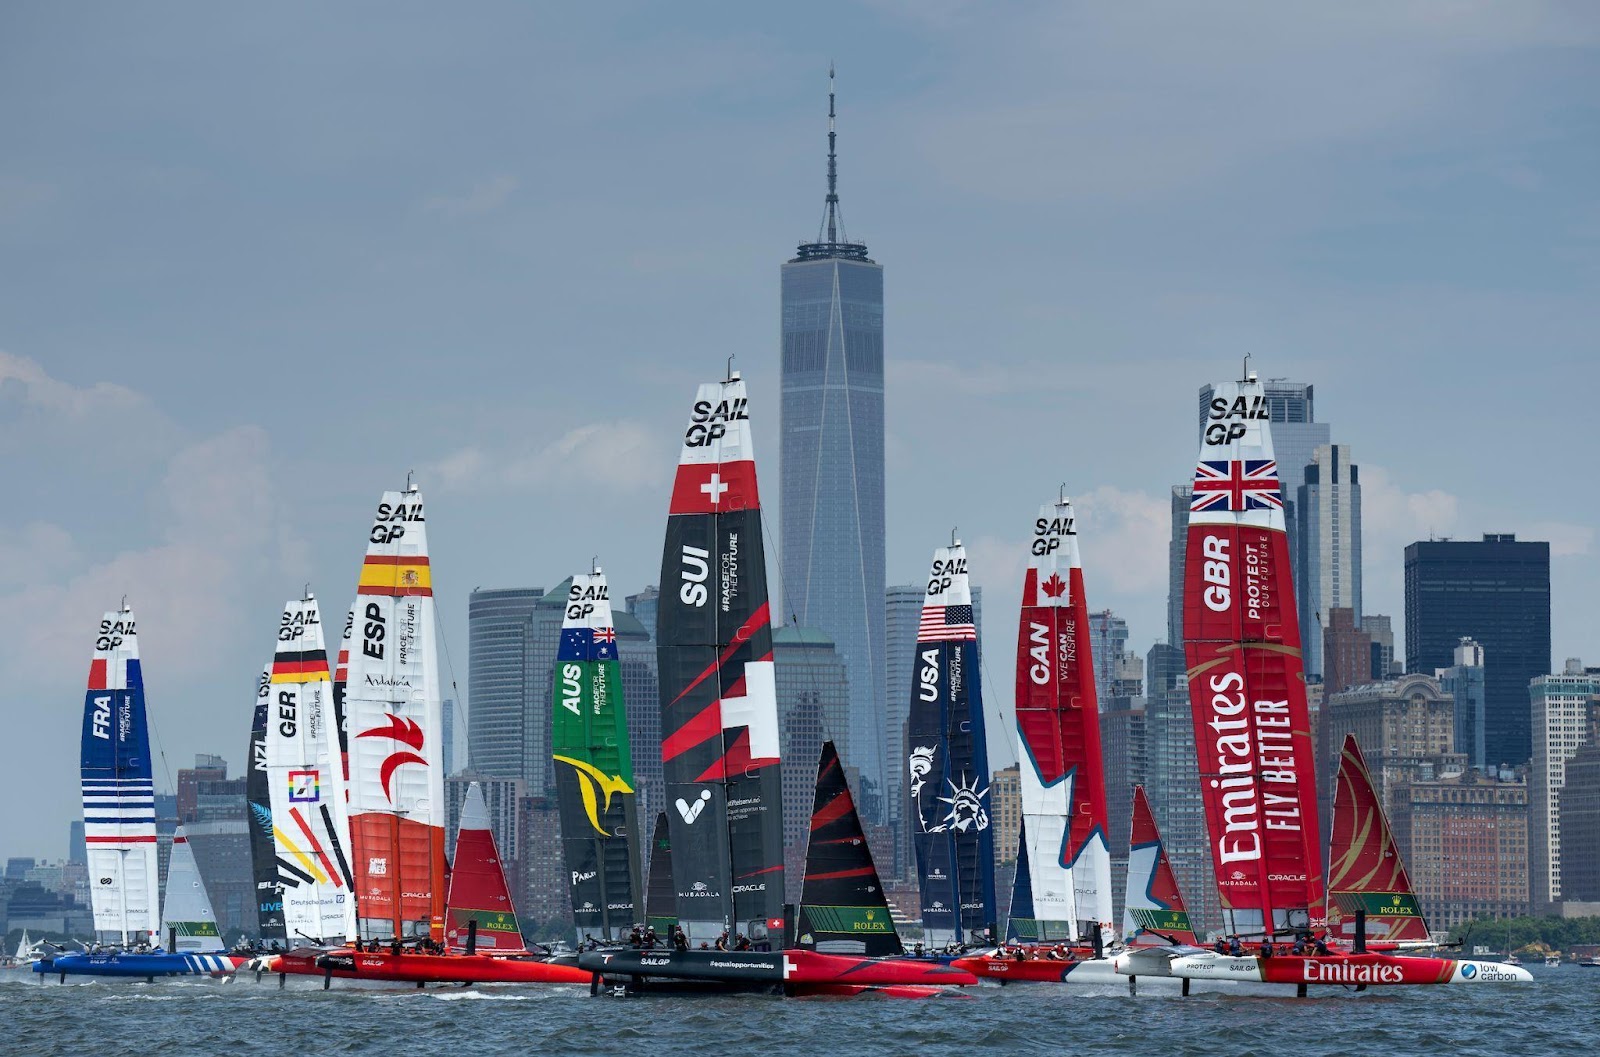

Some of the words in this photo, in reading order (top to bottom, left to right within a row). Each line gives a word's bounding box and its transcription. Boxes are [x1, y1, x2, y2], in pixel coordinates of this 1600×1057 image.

[691, 398, 749, 423] SAIL
[1209, 396, 1269, 420] SAIL
[685, 424, 725, 447] GP
[1205, 423, 1247, 446] GP
[375, 503, 425, 522] SAIL
[369, 525, 405, 544] GP
[1034, 518, 1077, 536] SAIL
[1031, 538, 1060, 556] GP
[1260, 535, 1269, 580] FUTURE
[680, 545, 709, 608] SUI
[931, 558, 968, 577] SAIL
[1203, 535, 1231, 612] GBR
[569, 585, 609, 601] SAIL
[927, 578, 952, 596] GP
[1246, 544, 1261, 620] PROTECT
[1261, 582, 1269, 607] OUR
[281, 610, 320, 625] SAIL
[567, 604, 594, 620] GP
[99, 620, 137, 635] SAIL
[278, 626, 304, 641] GP
[363, 602, 385, 660] ESP
[96, 636, 122, 651] GP
[1066, 619, 1075, 661] INSPIRE
[1030, 622, 1050, 685] CAN
[920, 649, 939, 702] USA
[1060, 662, 1068, 680] WE
[562, 663, 582, 716] AUS
[93, 696, 111, 740] FRA
[279, 690, 296, 738] GER
[1254, 699, 1297, 783] BETTER
[1207, 672, 1261, 865] Emirates
[1264, 792, 1300, 831] FLY
[258, 881, 285, 889] BLA
[733, 884, 766, 892] ORACLE
[854, 922, 885, 930] ROLEX
[710, 960, 774, 970] #equalopportunities
[1303, 959, 1403, 983] Emirates
[1480, 964, 1498, 973] low
[1481, 972, 1517, 981] carbon
